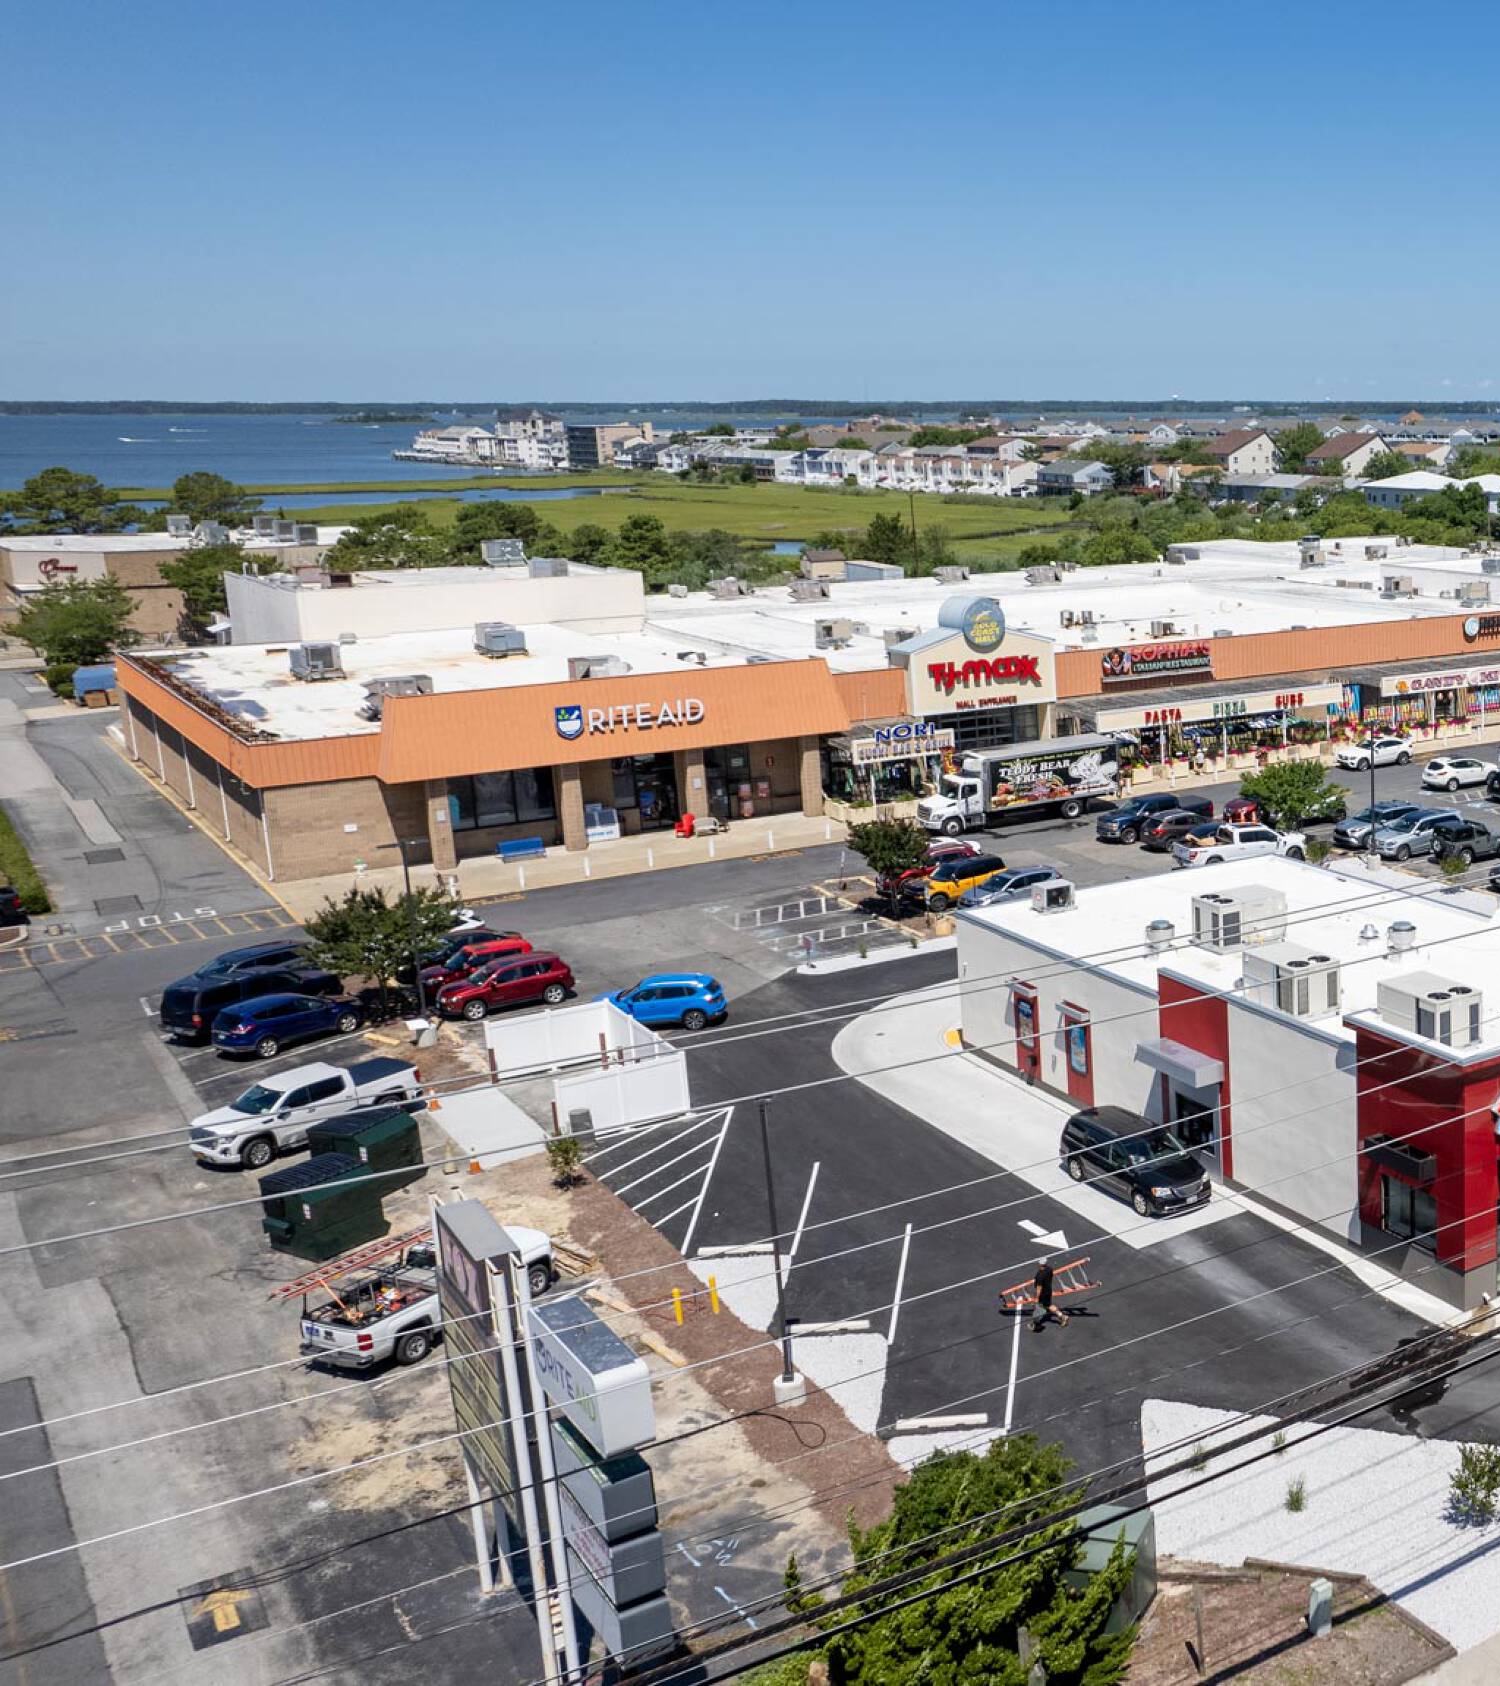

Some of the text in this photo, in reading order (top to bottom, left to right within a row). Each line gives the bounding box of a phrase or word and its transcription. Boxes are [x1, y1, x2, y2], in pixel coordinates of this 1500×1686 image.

[1411, 674, 1466, 691] CANDY
[956, 695, 1018, 710] MALL ENTRANCE
[1144, 692, 1304, 724] PASTA PIZZA SUBS
[587, 699, 705, 733] RITE AID
[875, 722, 936, 743] NORI
[1040, 759, 1071, 772] BEAR
[104, 906, 218, 934] STOP
